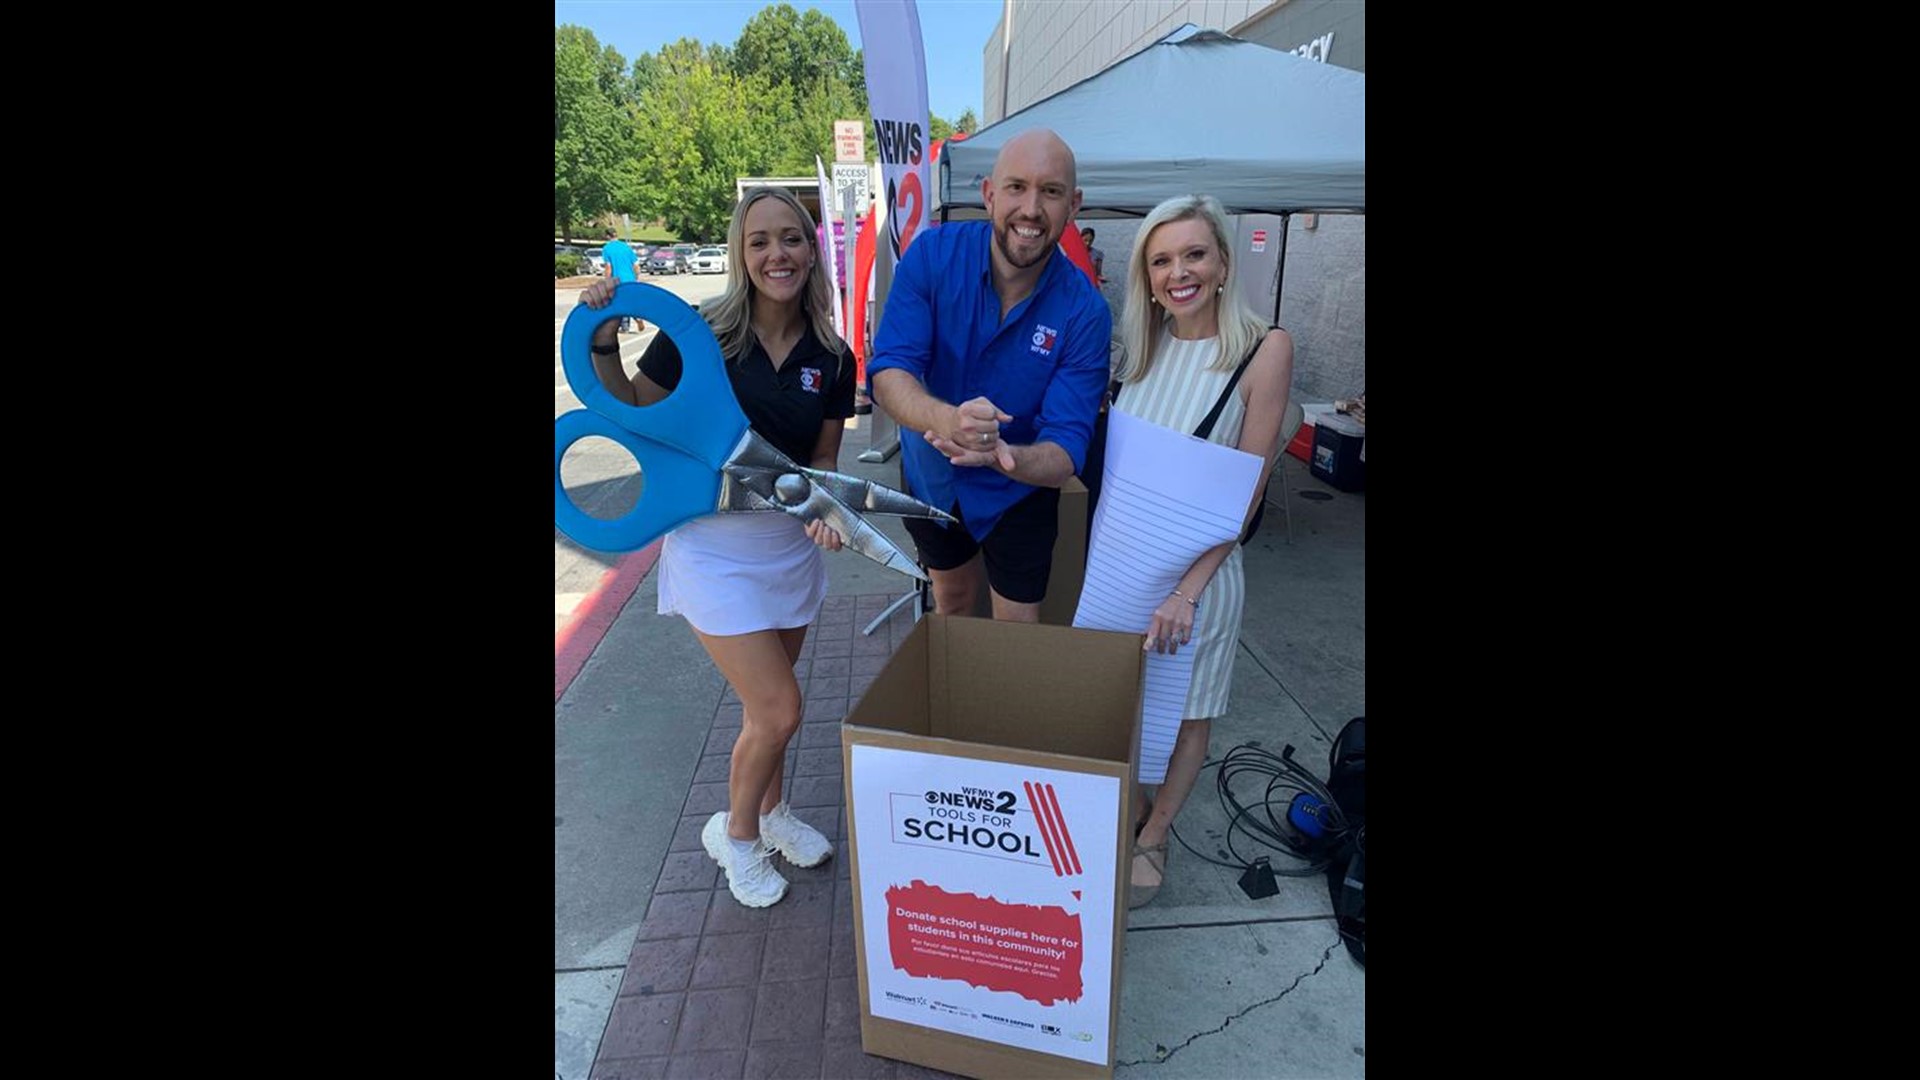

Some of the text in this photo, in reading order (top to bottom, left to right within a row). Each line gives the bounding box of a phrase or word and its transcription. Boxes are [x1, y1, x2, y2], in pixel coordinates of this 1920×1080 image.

[873, 119, 922, 165] NEWS
[835, 168, 867, 177] ACCESS
[838, 178, 848, 187] TO
[898, 172, 923, 256] 2
[961, 786, 995, 799] WFMY
[928, 806, 1012, 829] TOOLS FOR
[904, 818, 1040, 857] SCHOOL
[895, 907, 1079, 949] Donate school supplies here for
[907, 923, 1066, 960] students in this community!
